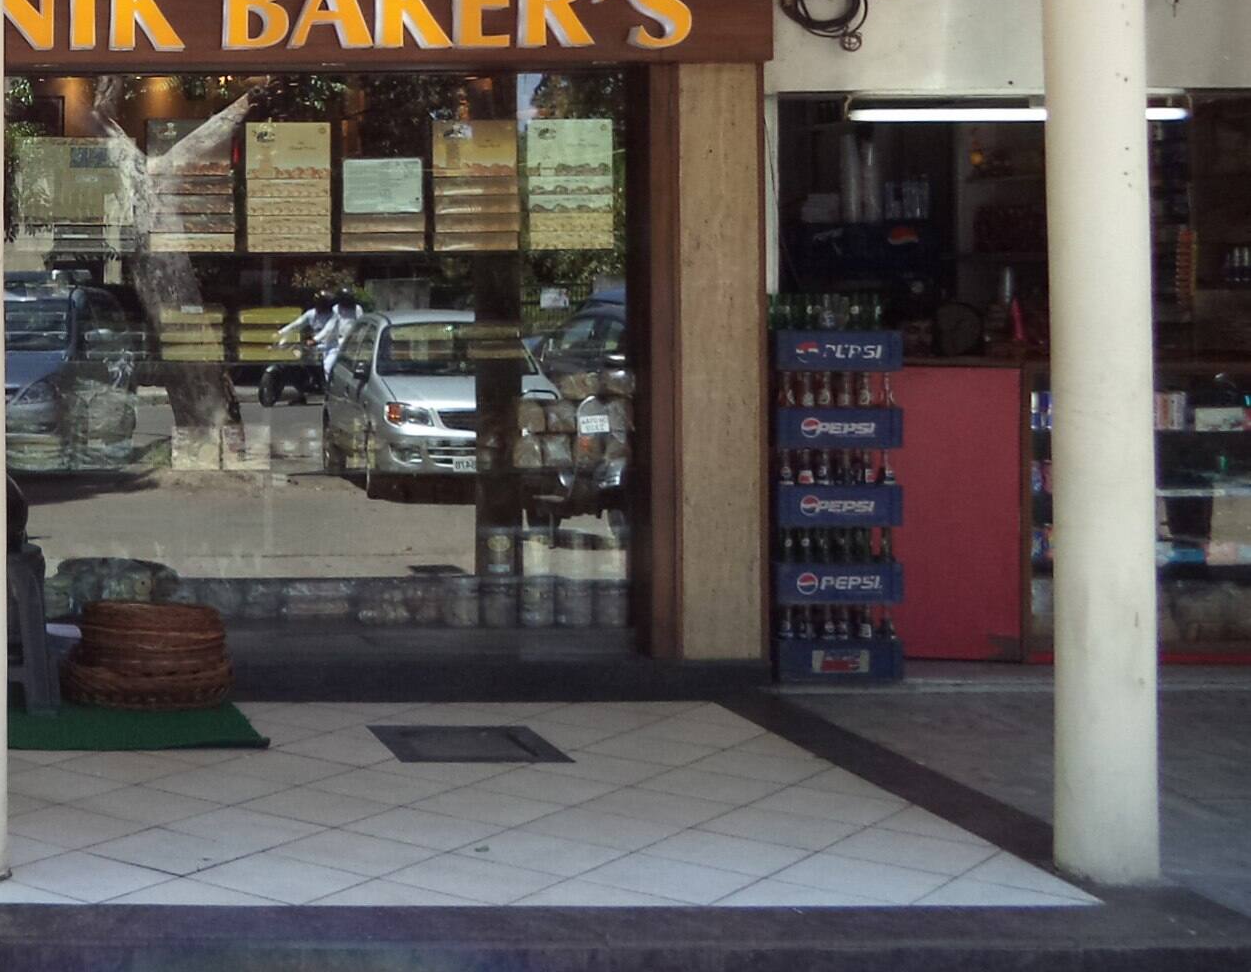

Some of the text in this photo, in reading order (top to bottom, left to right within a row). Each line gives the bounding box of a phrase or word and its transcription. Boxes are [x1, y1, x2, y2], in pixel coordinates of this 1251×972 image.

[816, 421, 876, 435] PEPSI
[816, 500, 876, 513] PEPSI
[820, 575, 882, 590] PEPSI
